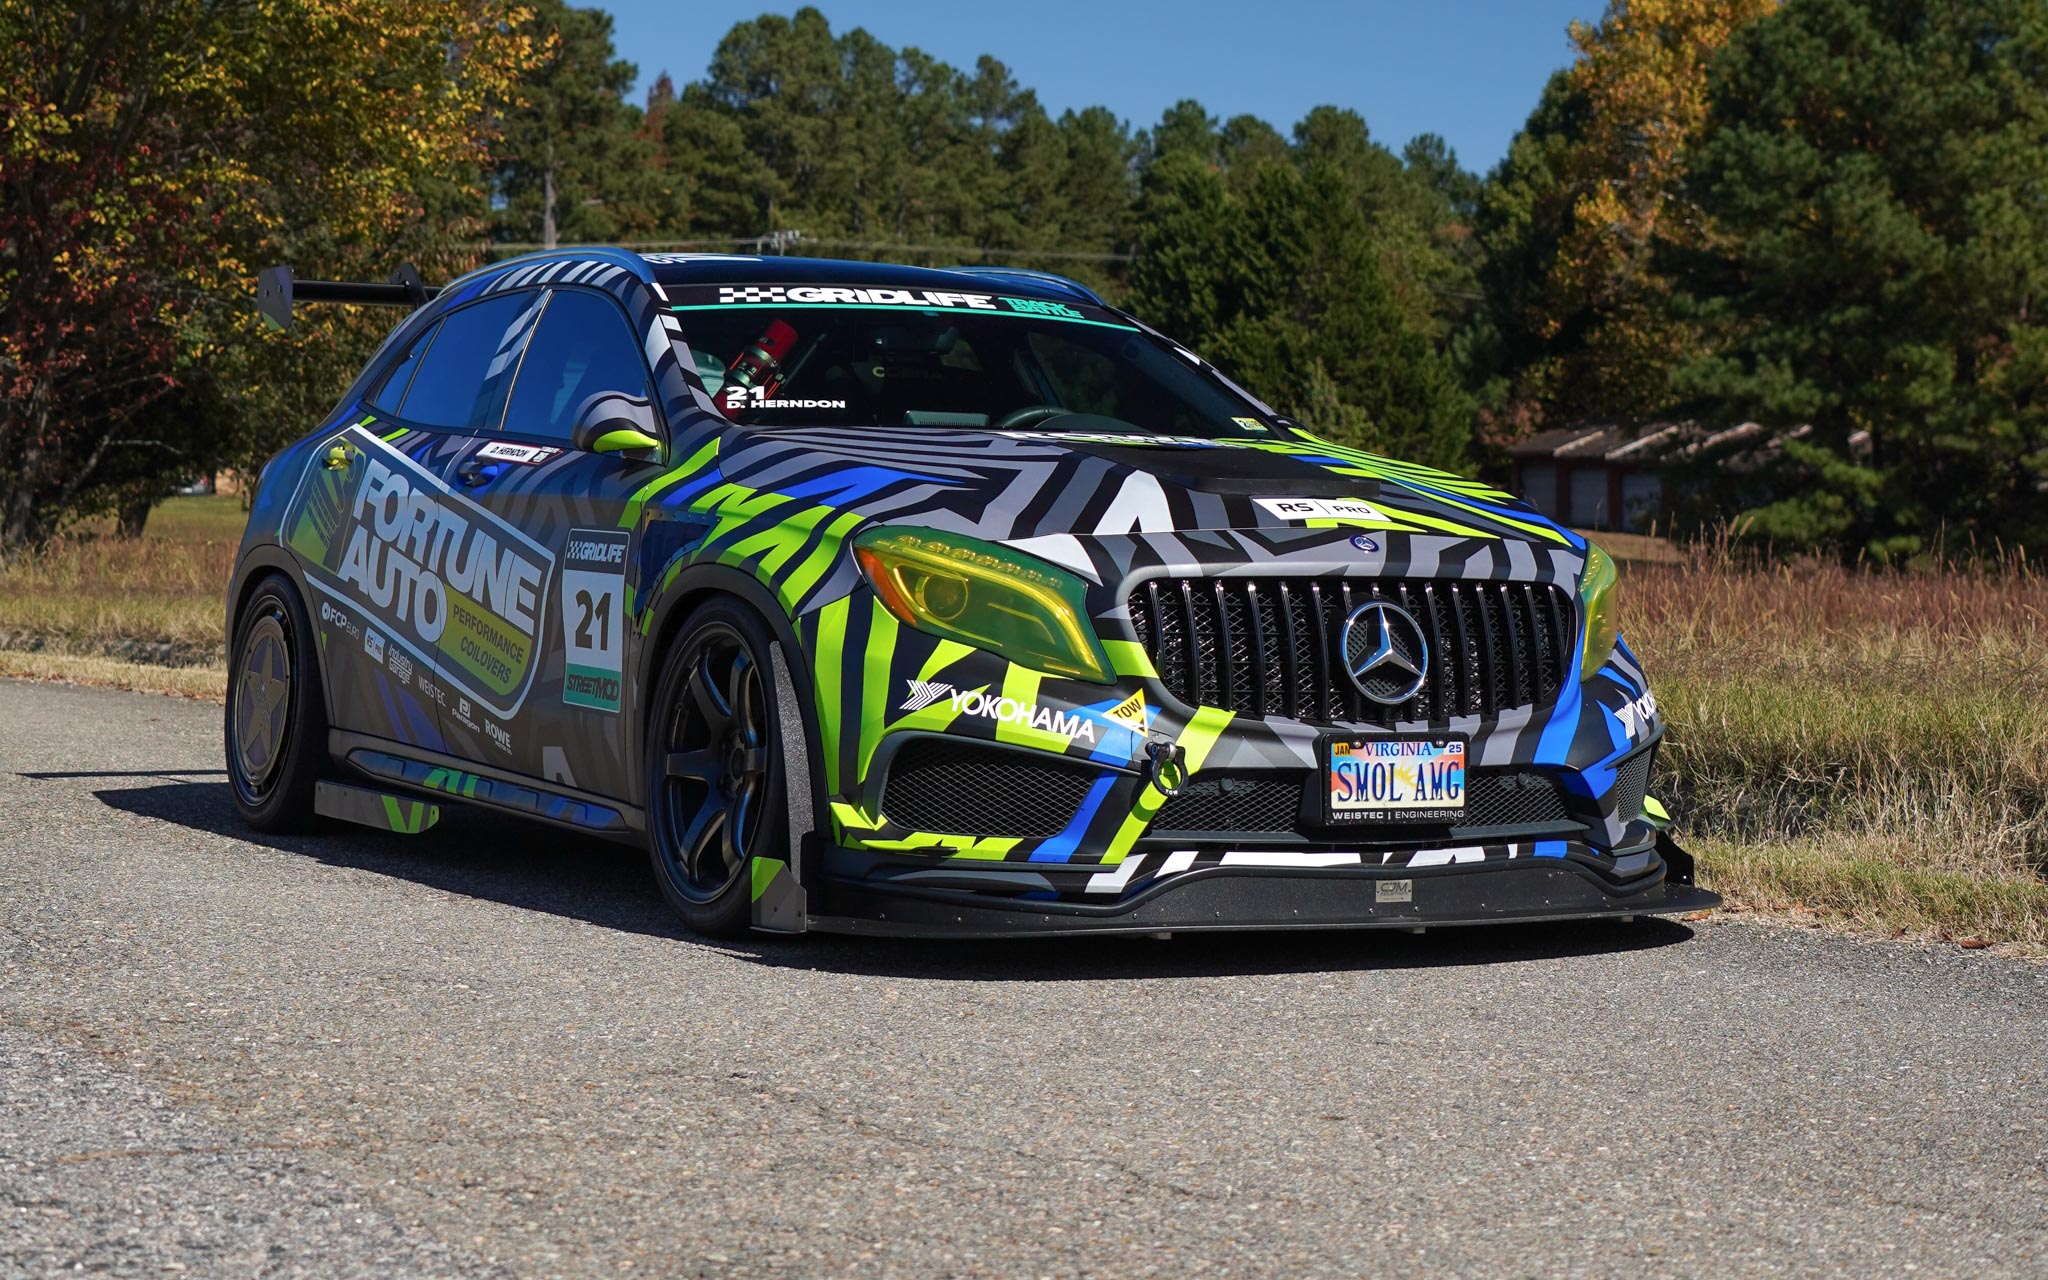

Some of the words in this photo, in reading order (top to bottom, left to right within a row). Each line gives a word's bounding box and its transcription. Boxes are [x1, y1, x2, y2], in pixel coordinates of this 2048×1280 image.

[786, 287, 997, 309] GRIDLIFE
[726, 385, 765, 400] 21
[726, 400, 746, 409] D.
[750, 400, 846, 408] HERNDON
[1277, 502, 1315, 513] RS
[1332, 505, 1372, 514] PRO
[353, 458, 542, 636] FORTUNE
[580, 541, 626, 564] GRIDLIFE
[338, 525, 448, 643] AUTO
[329, 607, 347, 629] FCP
[345, 621, 360, 640] EURO
[575, 589, 612, 651] 21
[453, 603, 525, 665] PERFORMANCE
[388, 643, 414, 672] Industry
[461, 636, 512, 684] COILOVERS
[418, 675, 447, 708] WEISTEC
[452, 707, 480, 734] Paragon
[949, 687, 1096, 744] YOKOHAMA
[1113, 698, 1142, 719] TOW
[484, 718, 512, 749] ROWE
[1335, 744, 1351, 756] JAN
[1364, 742, 1433, 757] VIRGINIA
[1448, 743, 1462, 753] 25
[1165, 788, 1179, 796] TOW
[1337, 762, 1404, 802] SMOL
[1412, 761, 1460, 802] AMG
[1332, 811, 1384, 820] WEISTEC
[1395, 810, 1465, 819] ENGINEERING
[1380, 882, 1408, 892] CJM
